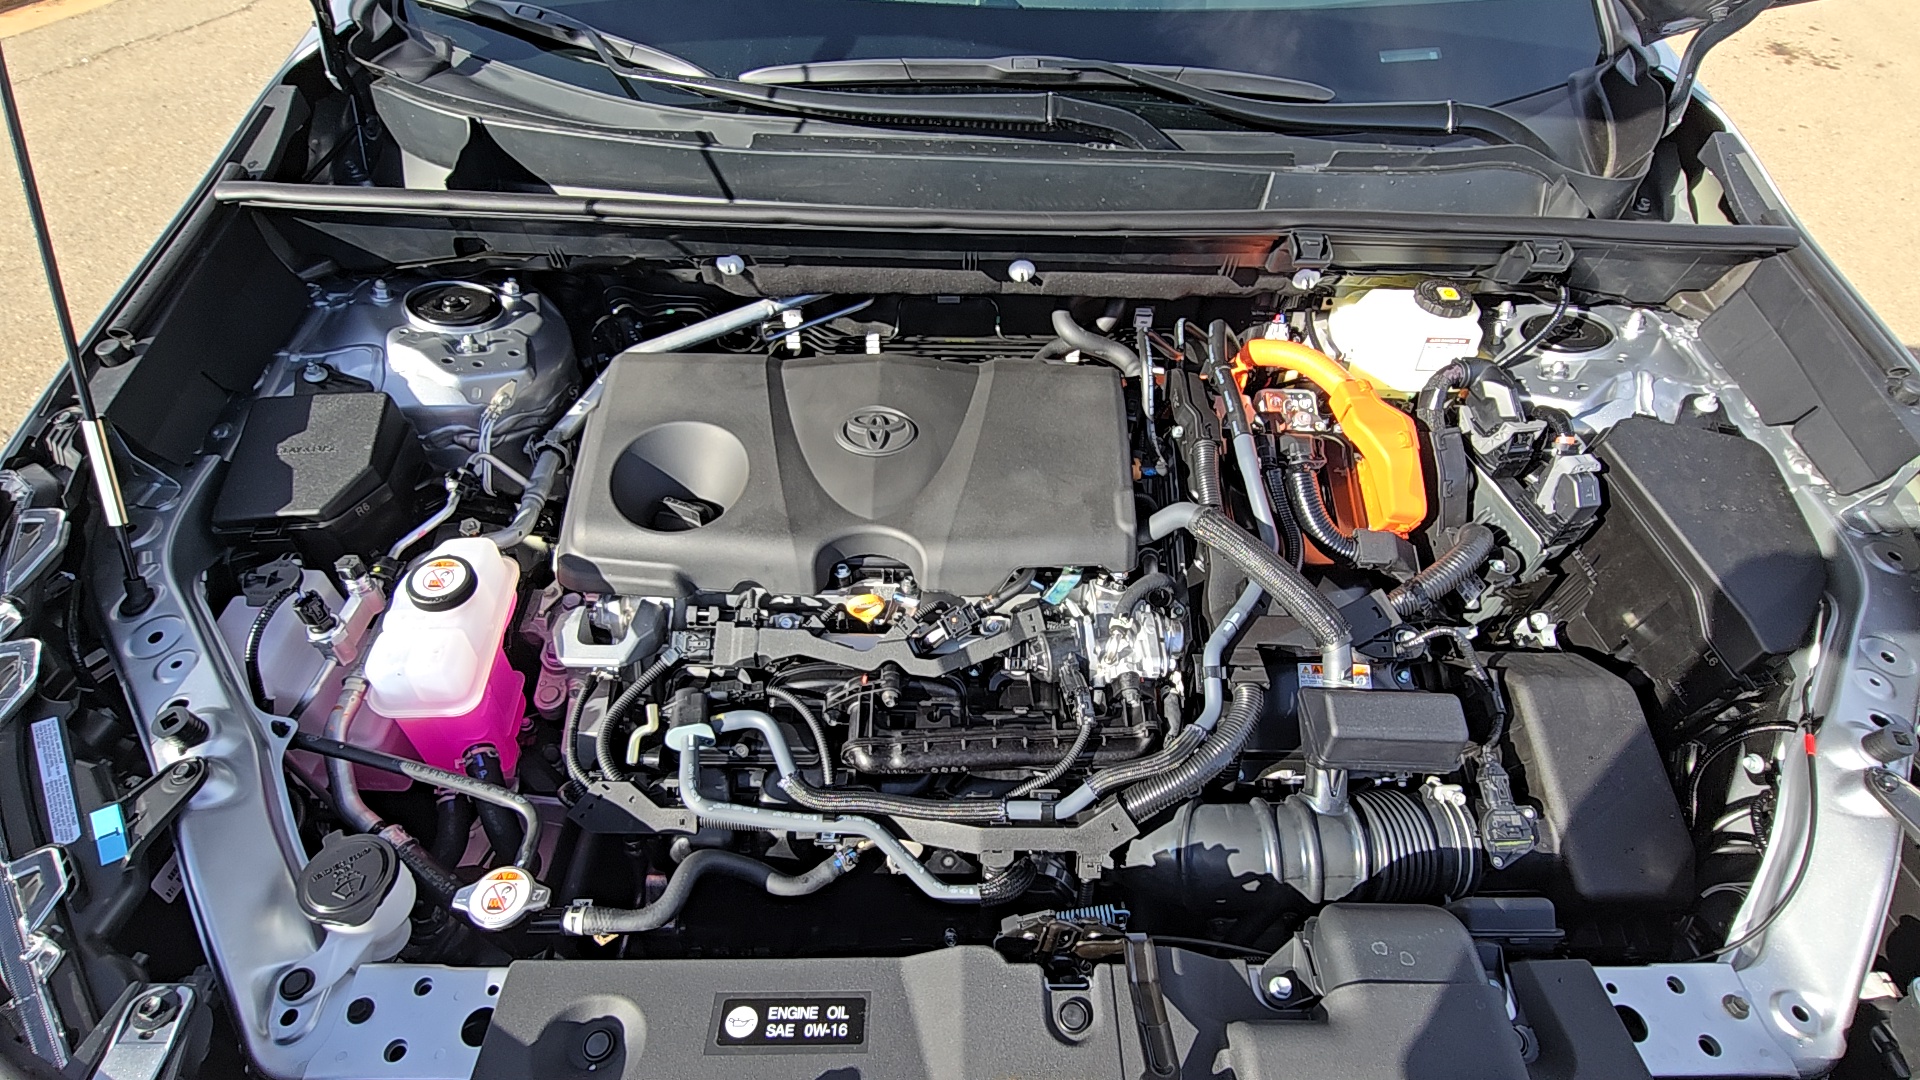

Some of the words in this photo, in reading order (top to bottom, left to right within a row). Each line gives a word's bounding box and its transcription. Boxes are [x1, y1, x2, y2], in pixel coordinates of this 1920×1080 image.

[354, 502, 371, 517] R6
[1703, 650, 1719, 667] L6
[767, 1006, 819, 1020] ENGINE
[826, 1005, 850, 1020] OIL
[765, 1023, 796, 1038] SAE
[804, 1023, 849, 1038] 0W-16
